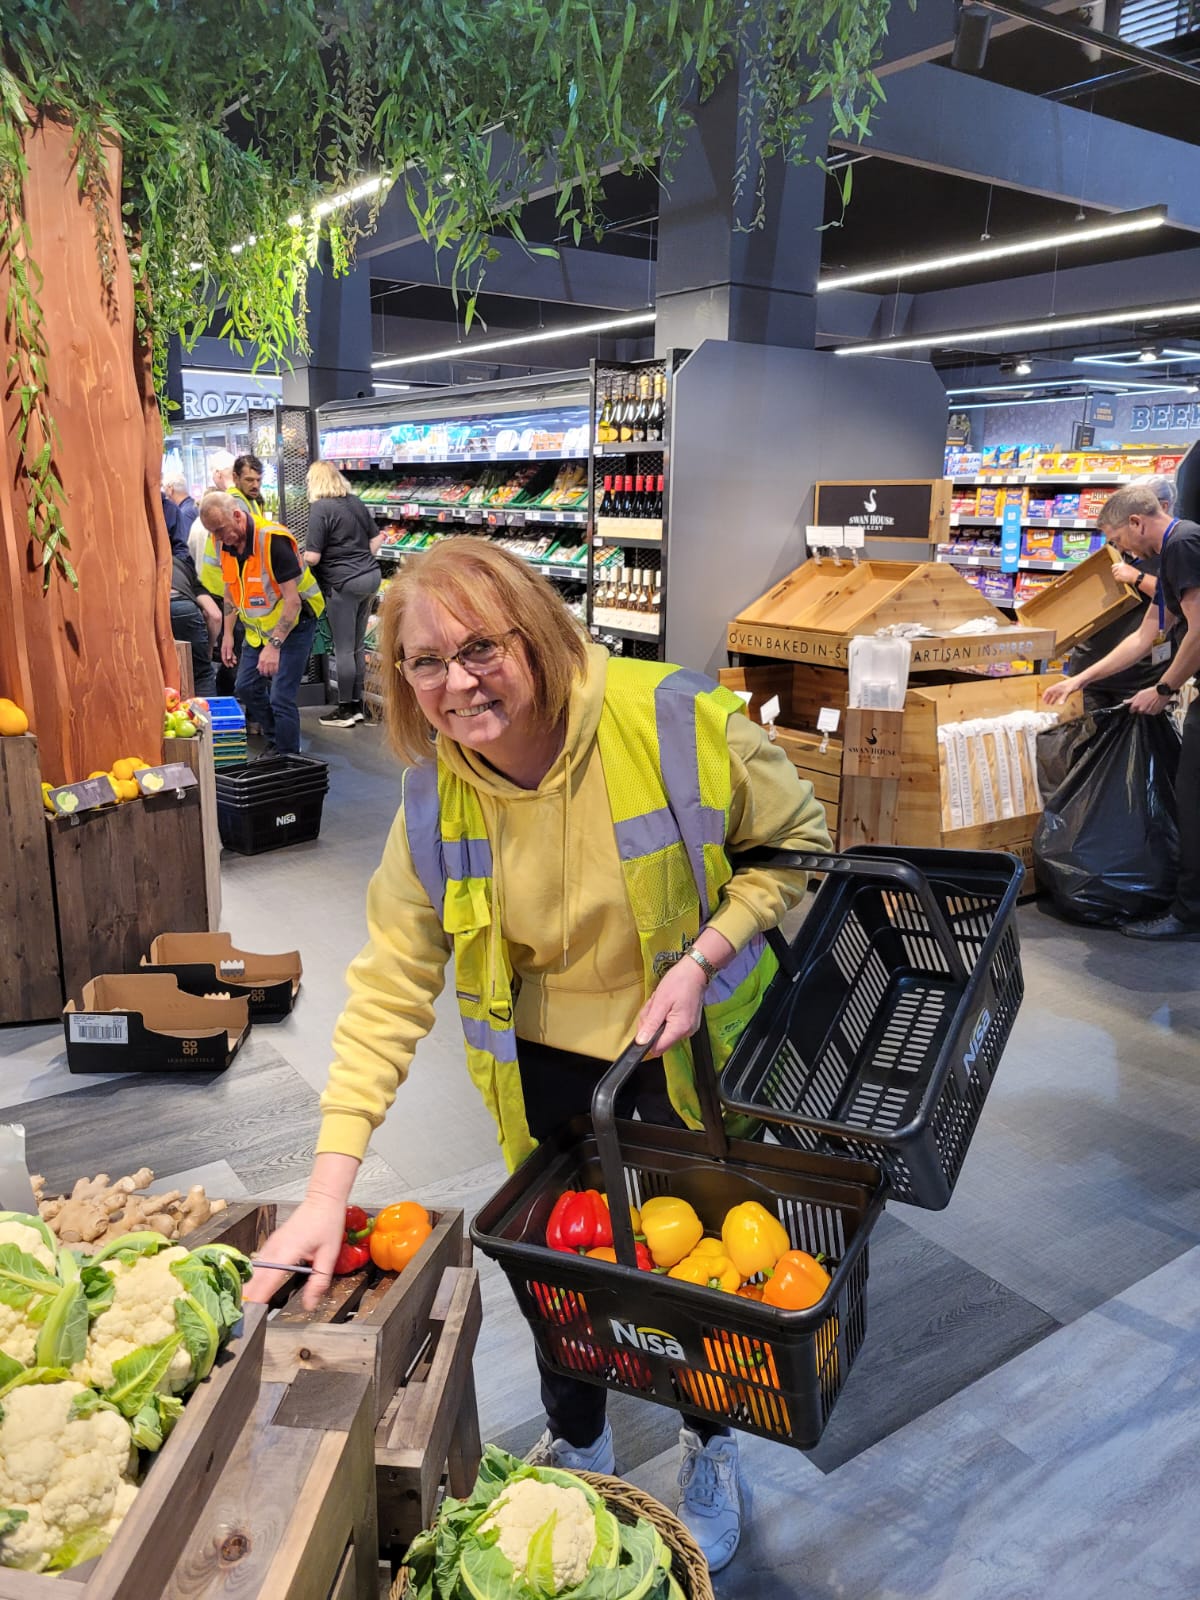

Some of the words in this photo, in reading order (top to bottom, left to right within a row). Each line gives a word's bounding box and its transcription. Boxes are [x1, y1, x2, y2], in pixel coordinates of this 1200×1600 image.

[848, 514, 869, 525] SWAN
[870, 514, 895, 526] HOUSE
[729, 632, 762, 649] OVEN
[766, 637, 809, 654] BAKED
[813, 643, 849, 659] IN-ST
[913, 646, 971, 663] ARTISAN
[977, 640, 1034, 657] INSPIRED
[848, 746, 869, 754] SWAN
[871, 747, 896, 757] HOUSE
[276, 814, 296, 826] Nisa
[963, 1009, 991, 1077] Nisa
[609, 1318, 686, 1361] Nisa
